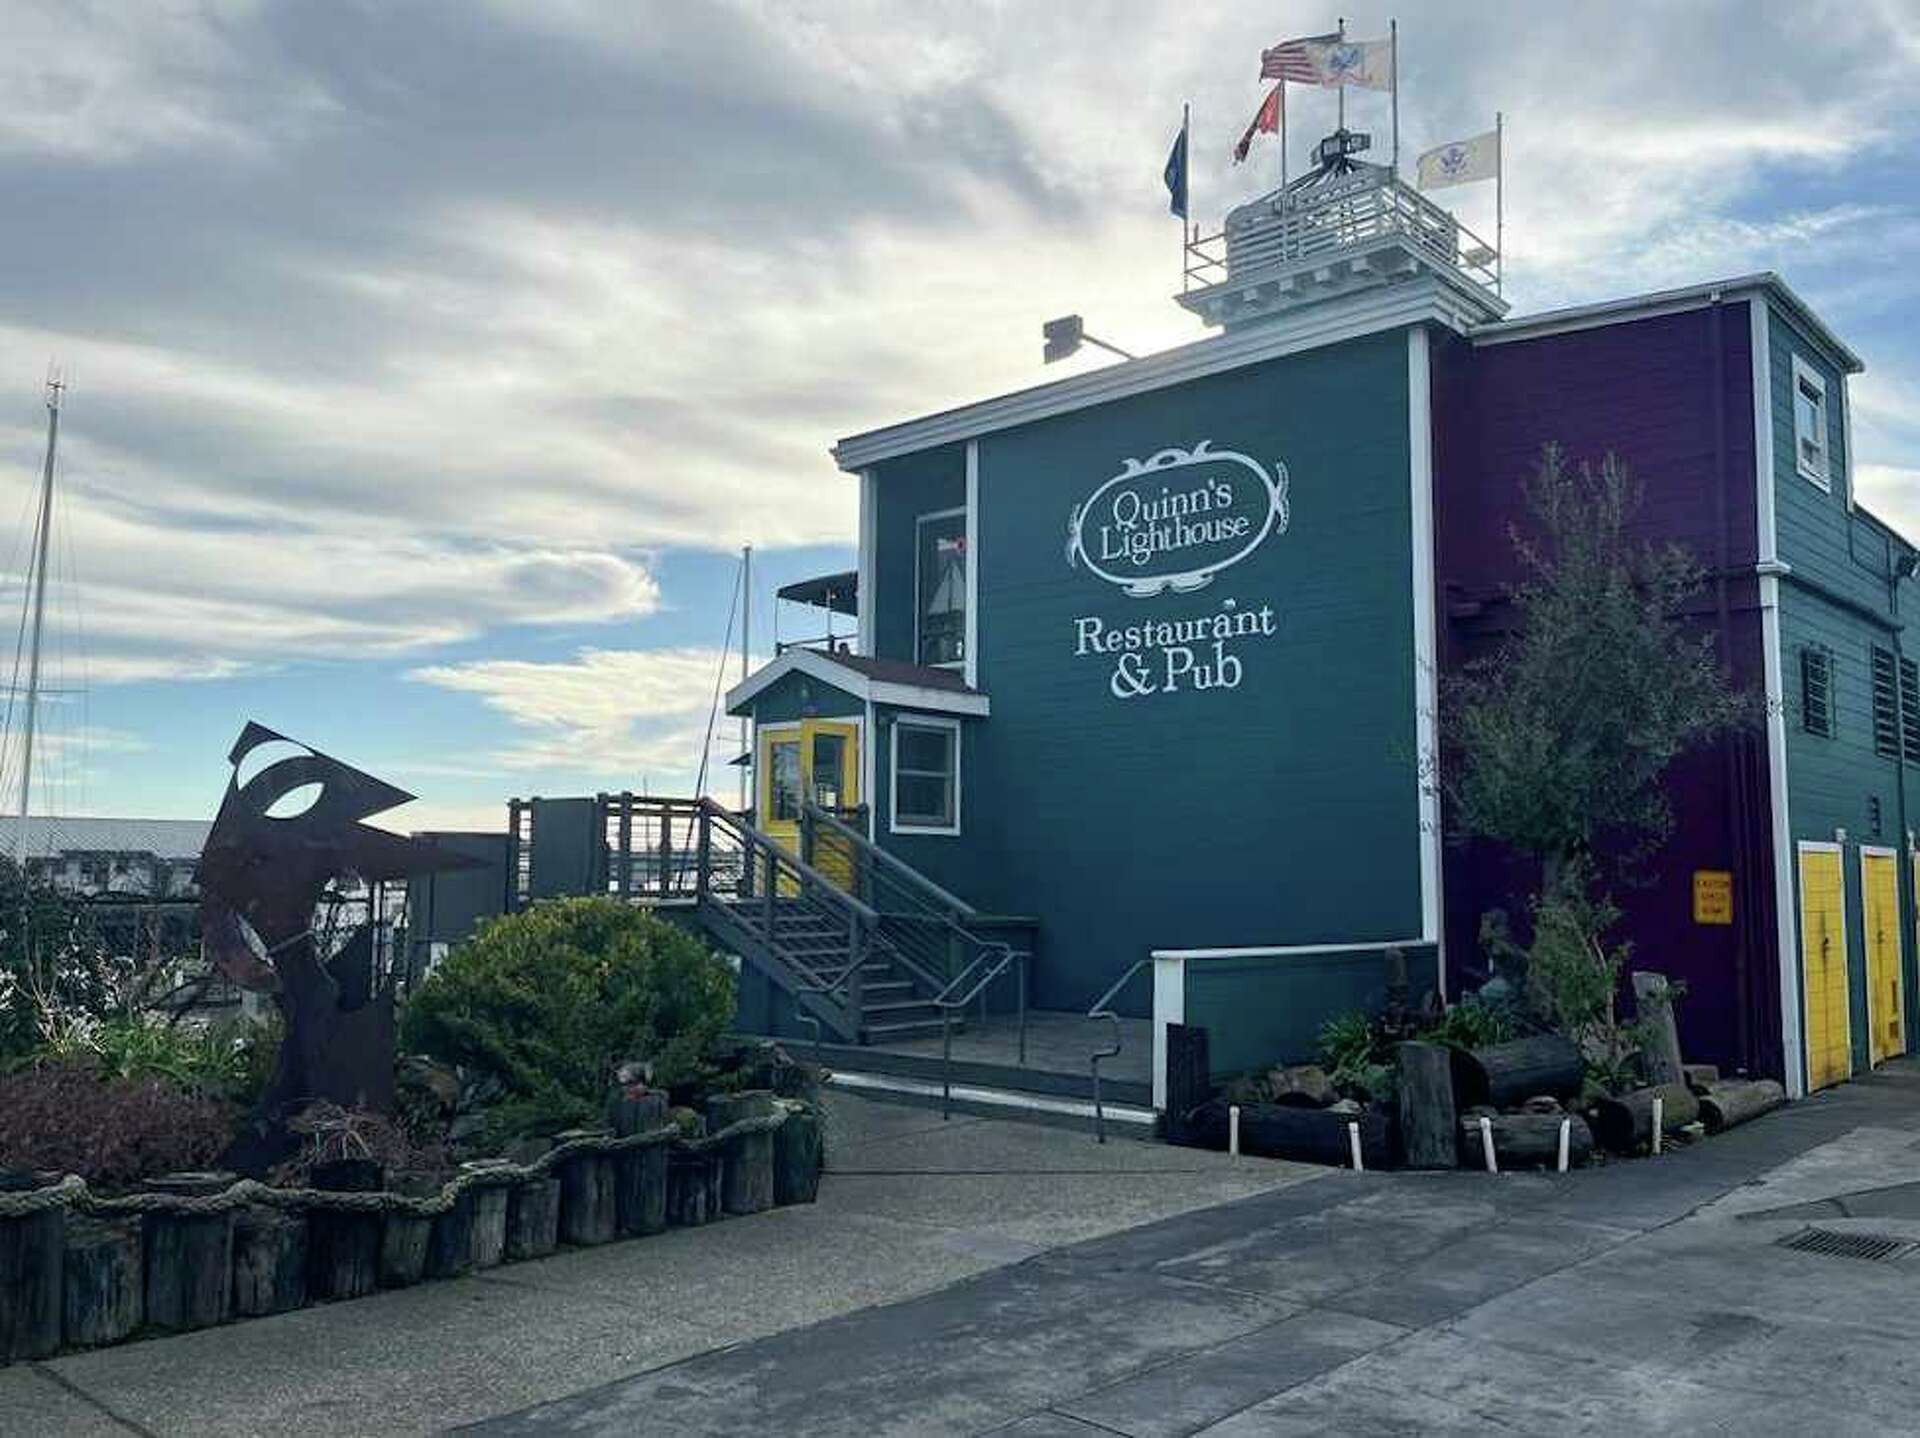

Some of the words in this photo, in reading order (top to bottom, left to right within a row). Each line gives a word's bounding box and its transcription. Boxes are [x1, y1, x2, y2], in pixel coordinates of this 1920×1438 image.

[1113, 479, 1232, 529] Quinn's
[1101, 517, 1250, 565] Lighthouse
[1074, 605, 1276, 655] Restaurant
[1111, 653, 1156, 698] &
[1163, 641, 1243, 692] Pub
